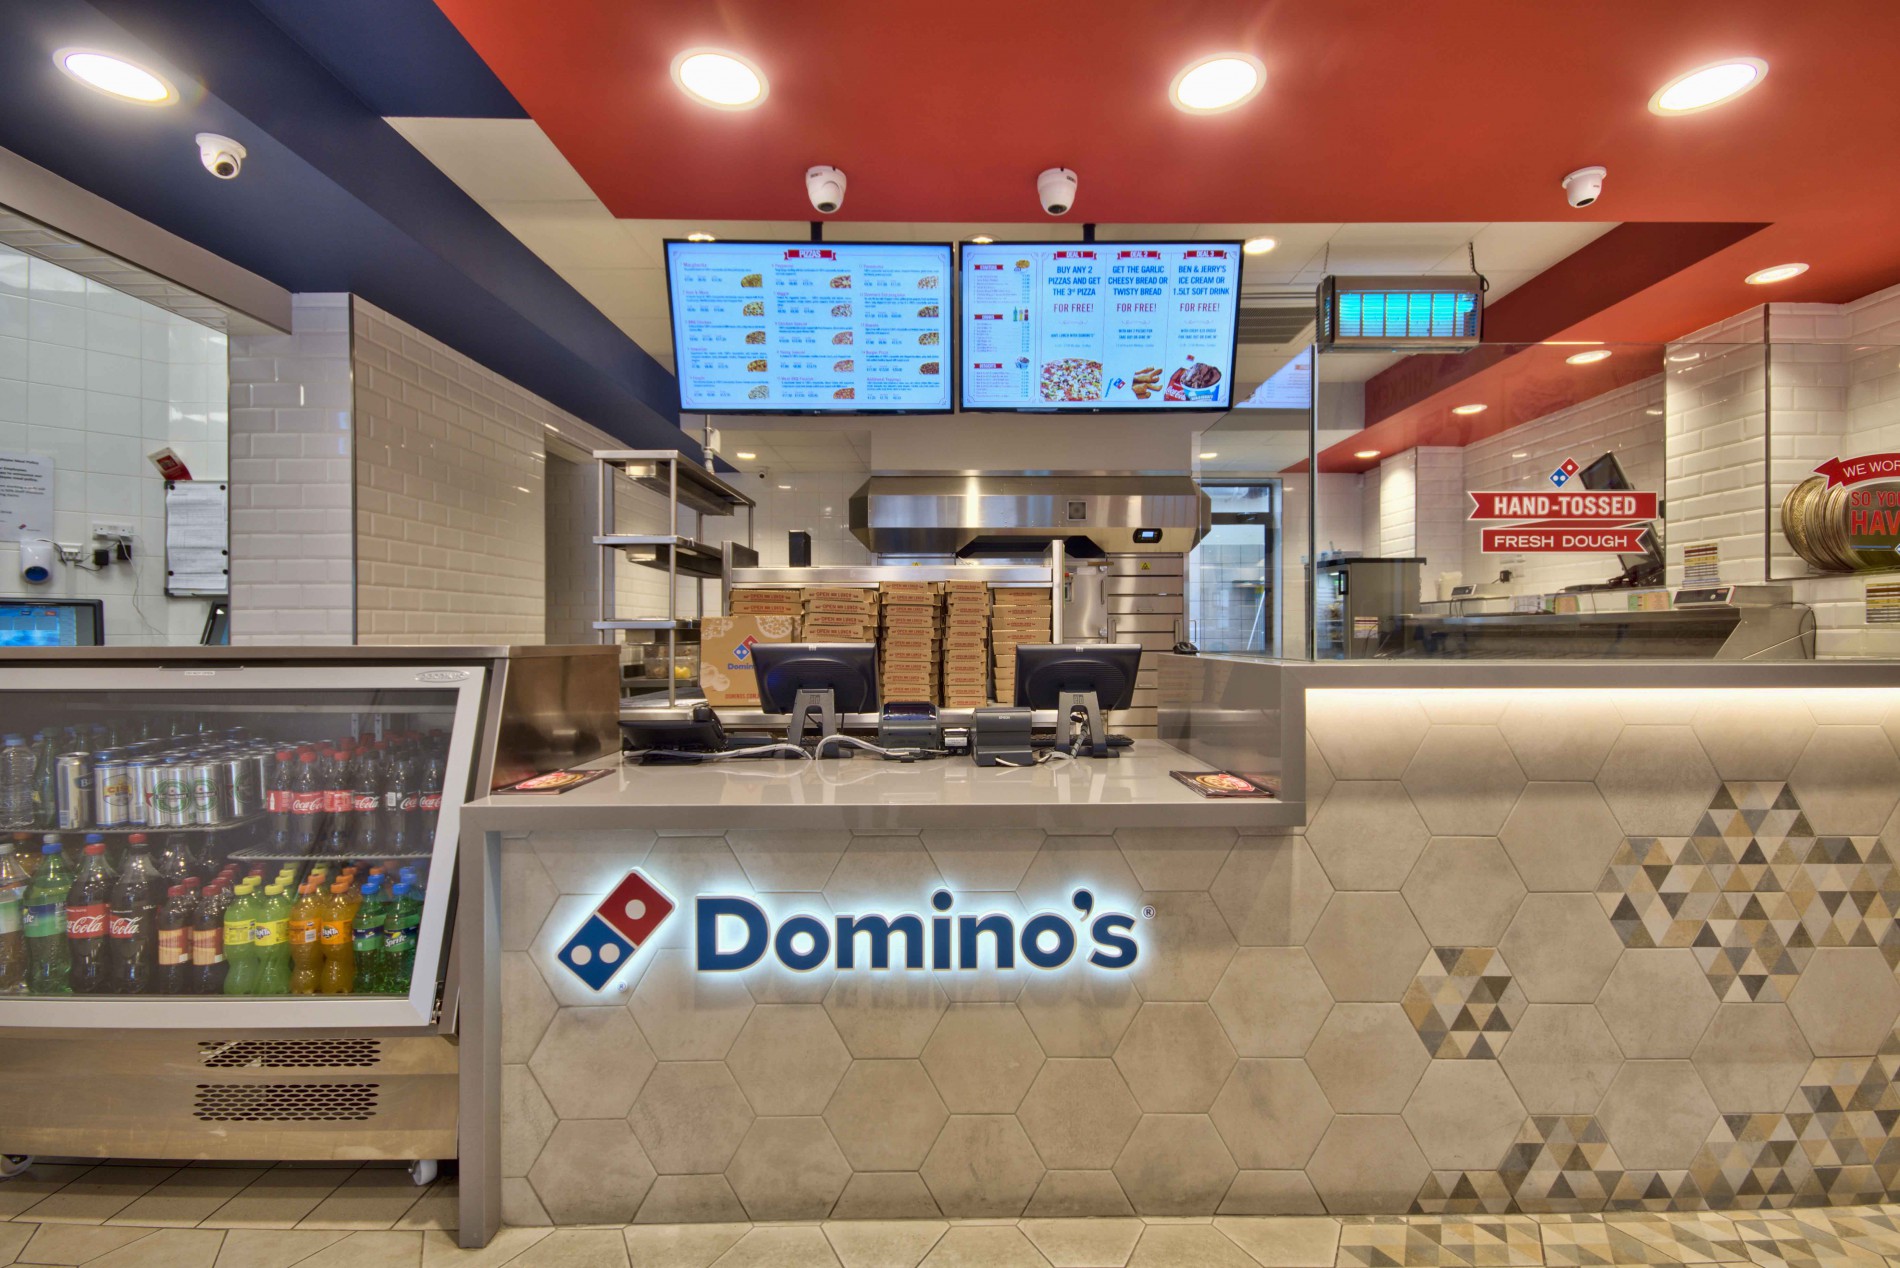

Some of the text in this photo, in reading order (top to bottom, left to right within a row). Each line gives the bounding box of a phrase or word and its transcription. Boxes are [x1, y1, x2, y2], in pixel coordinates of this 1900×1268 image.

[800, 249, 820, 258] PIZZAS
[1179, 276, 1225, 284] ICE CREAM OR
[1053, 288, 1065, 296] THE
[1077, 288, 1096, 296] PIZZA
[1054, 304, 1094, 312] FOR FREE!
[1117, 303, 1156, 312] FOR FREE!
[1180, 303, 1220, 312] FOR FREE!
[1843, 463, 1866, 478] WE
[1851, 491, 1871, 507] SO
[1494, 496, 1636, 516] HAND-TOSSED
[1494, 536, 1627, 548] FRESH DOUGH
[694, 886, 1139, 972] Domino's
[385, 935, 406, 948] Sprite
